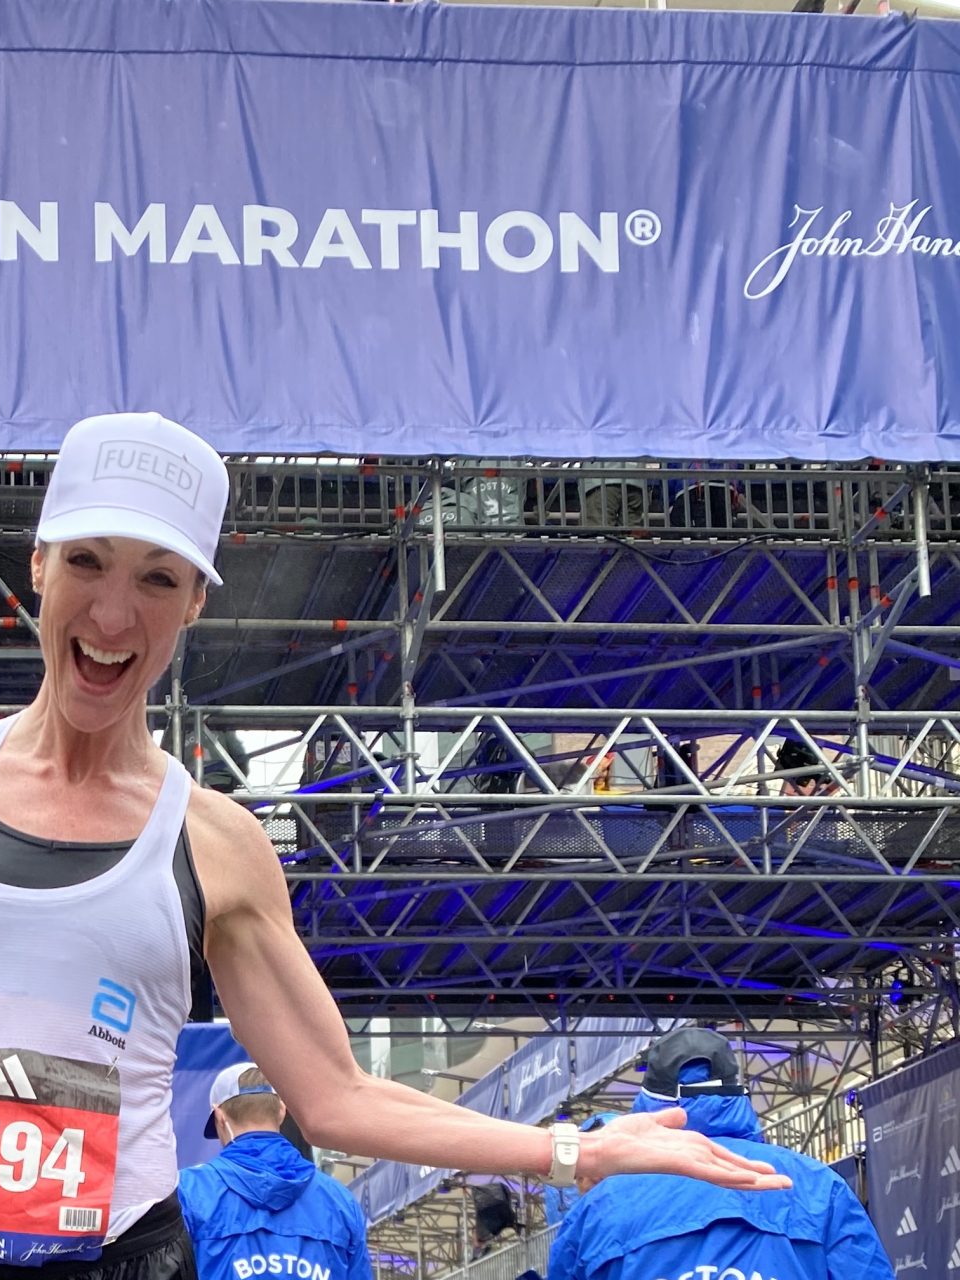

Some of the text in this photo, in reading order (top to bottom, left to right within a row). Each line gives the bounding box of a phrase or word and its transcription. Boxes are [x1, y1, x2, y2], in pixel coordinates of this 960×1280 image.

[743, 203, 863, 300] John
[104, 449, 193, 490] FUELED
[88, 1025, 126, 1050] Abbott
